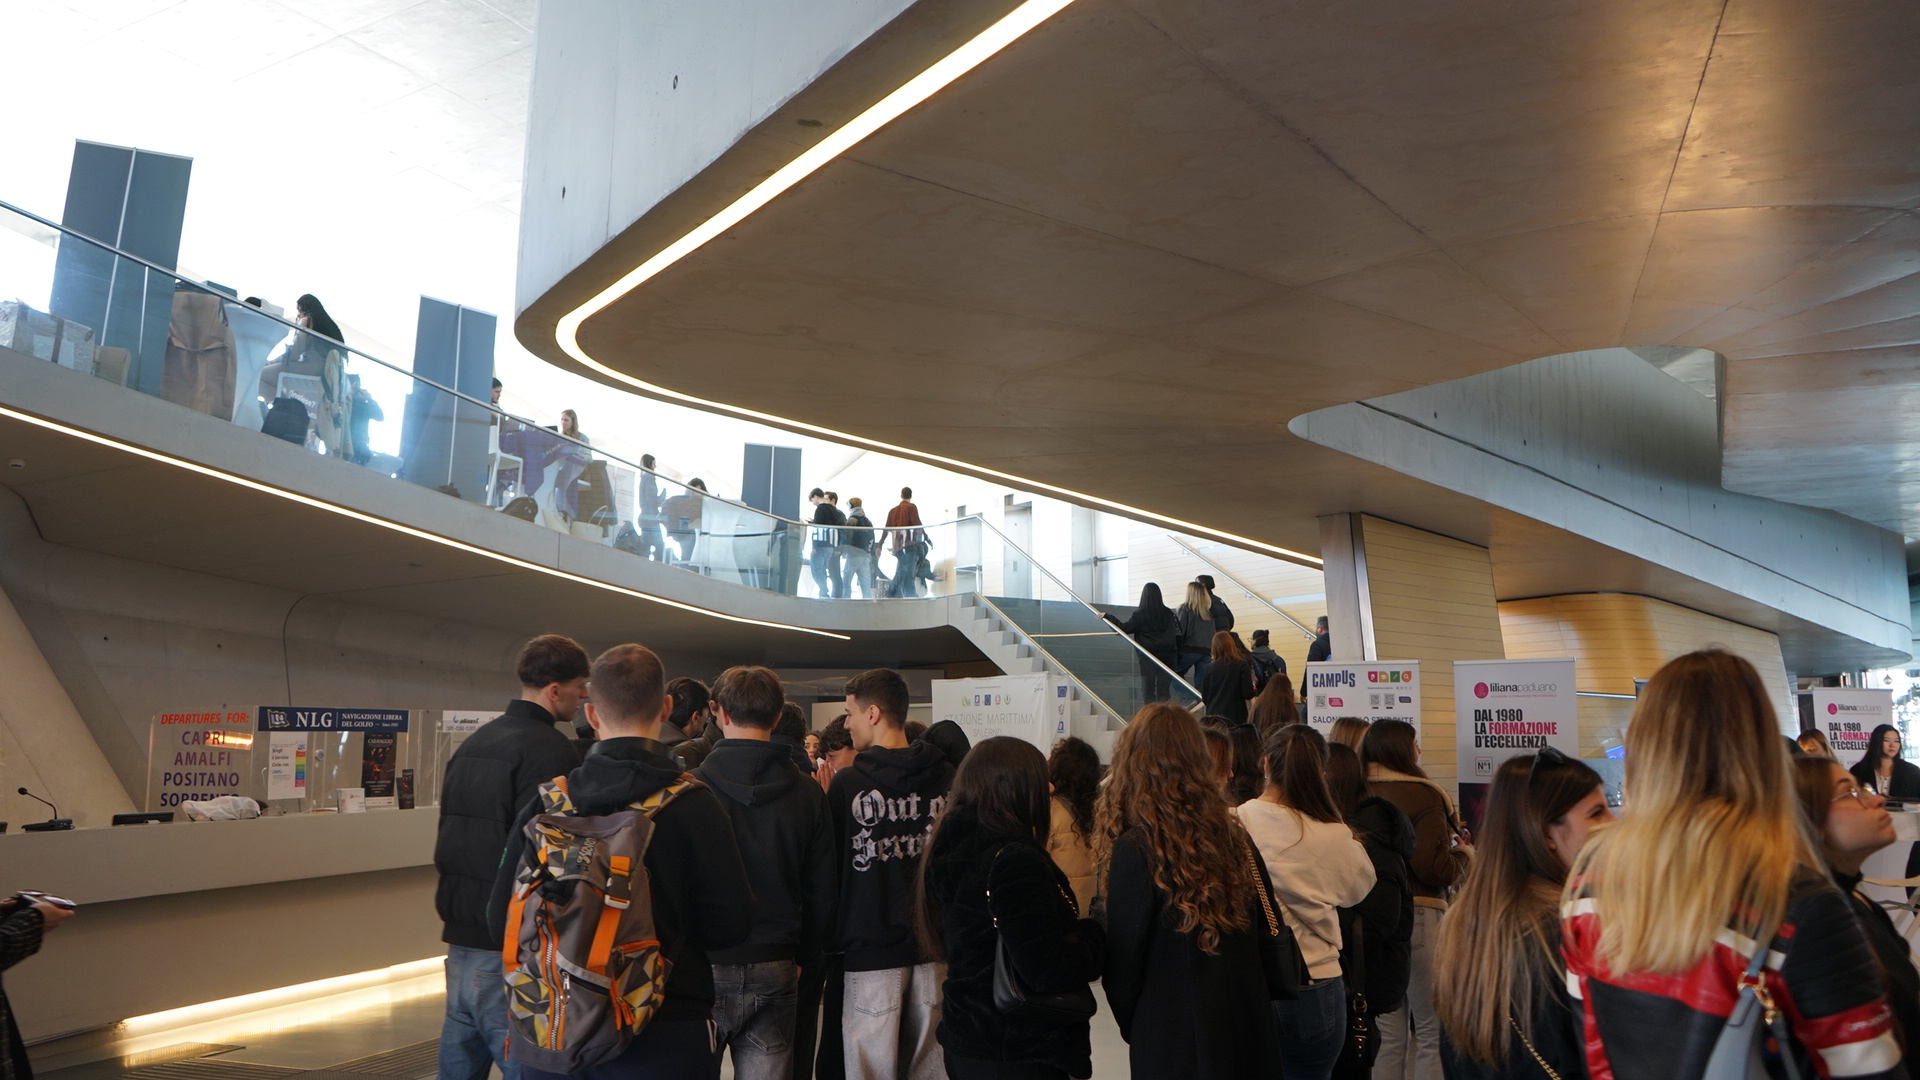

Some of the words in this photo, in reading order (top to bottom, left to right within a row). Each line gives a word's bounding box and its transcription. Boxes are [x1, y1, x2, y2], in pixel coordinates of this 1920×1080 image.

[1312, 670, 1356, 688] CAMPUS
[160, 713, 221, 725] DEPARTURES
[226, 713, 250, 724] FOR:
[296, 711, 332, 728] NLG
[987, 712, 1035, 725] MARITTIMA
[1312, 715, 1341, 724] SALON
[1474, 709, 1493, 722] DAL
[1495, 709, 1523, 722] 1980
[973, 728, 1003, 738] SALERNO
[1475, 723, 1487, 735] LA
[1489, 722, 1558, 735] FORMAZIONE
[1829, 723, 1842, 731] DAL
[1843, 723, 1861, 731] 1980
[182, 731, 226, 746] CAPRI
[1830, 732, 1839, 741] LA
[1839, 732, 1872, 741] FORMAZI
[174, 751, 231, 766] AMALFI
[163, 772, 240, 787] POSITANO
[851, 788, 922, 827] Out
[927, 791, 953, 820] o
[851, 824, 934, 872] Servi
